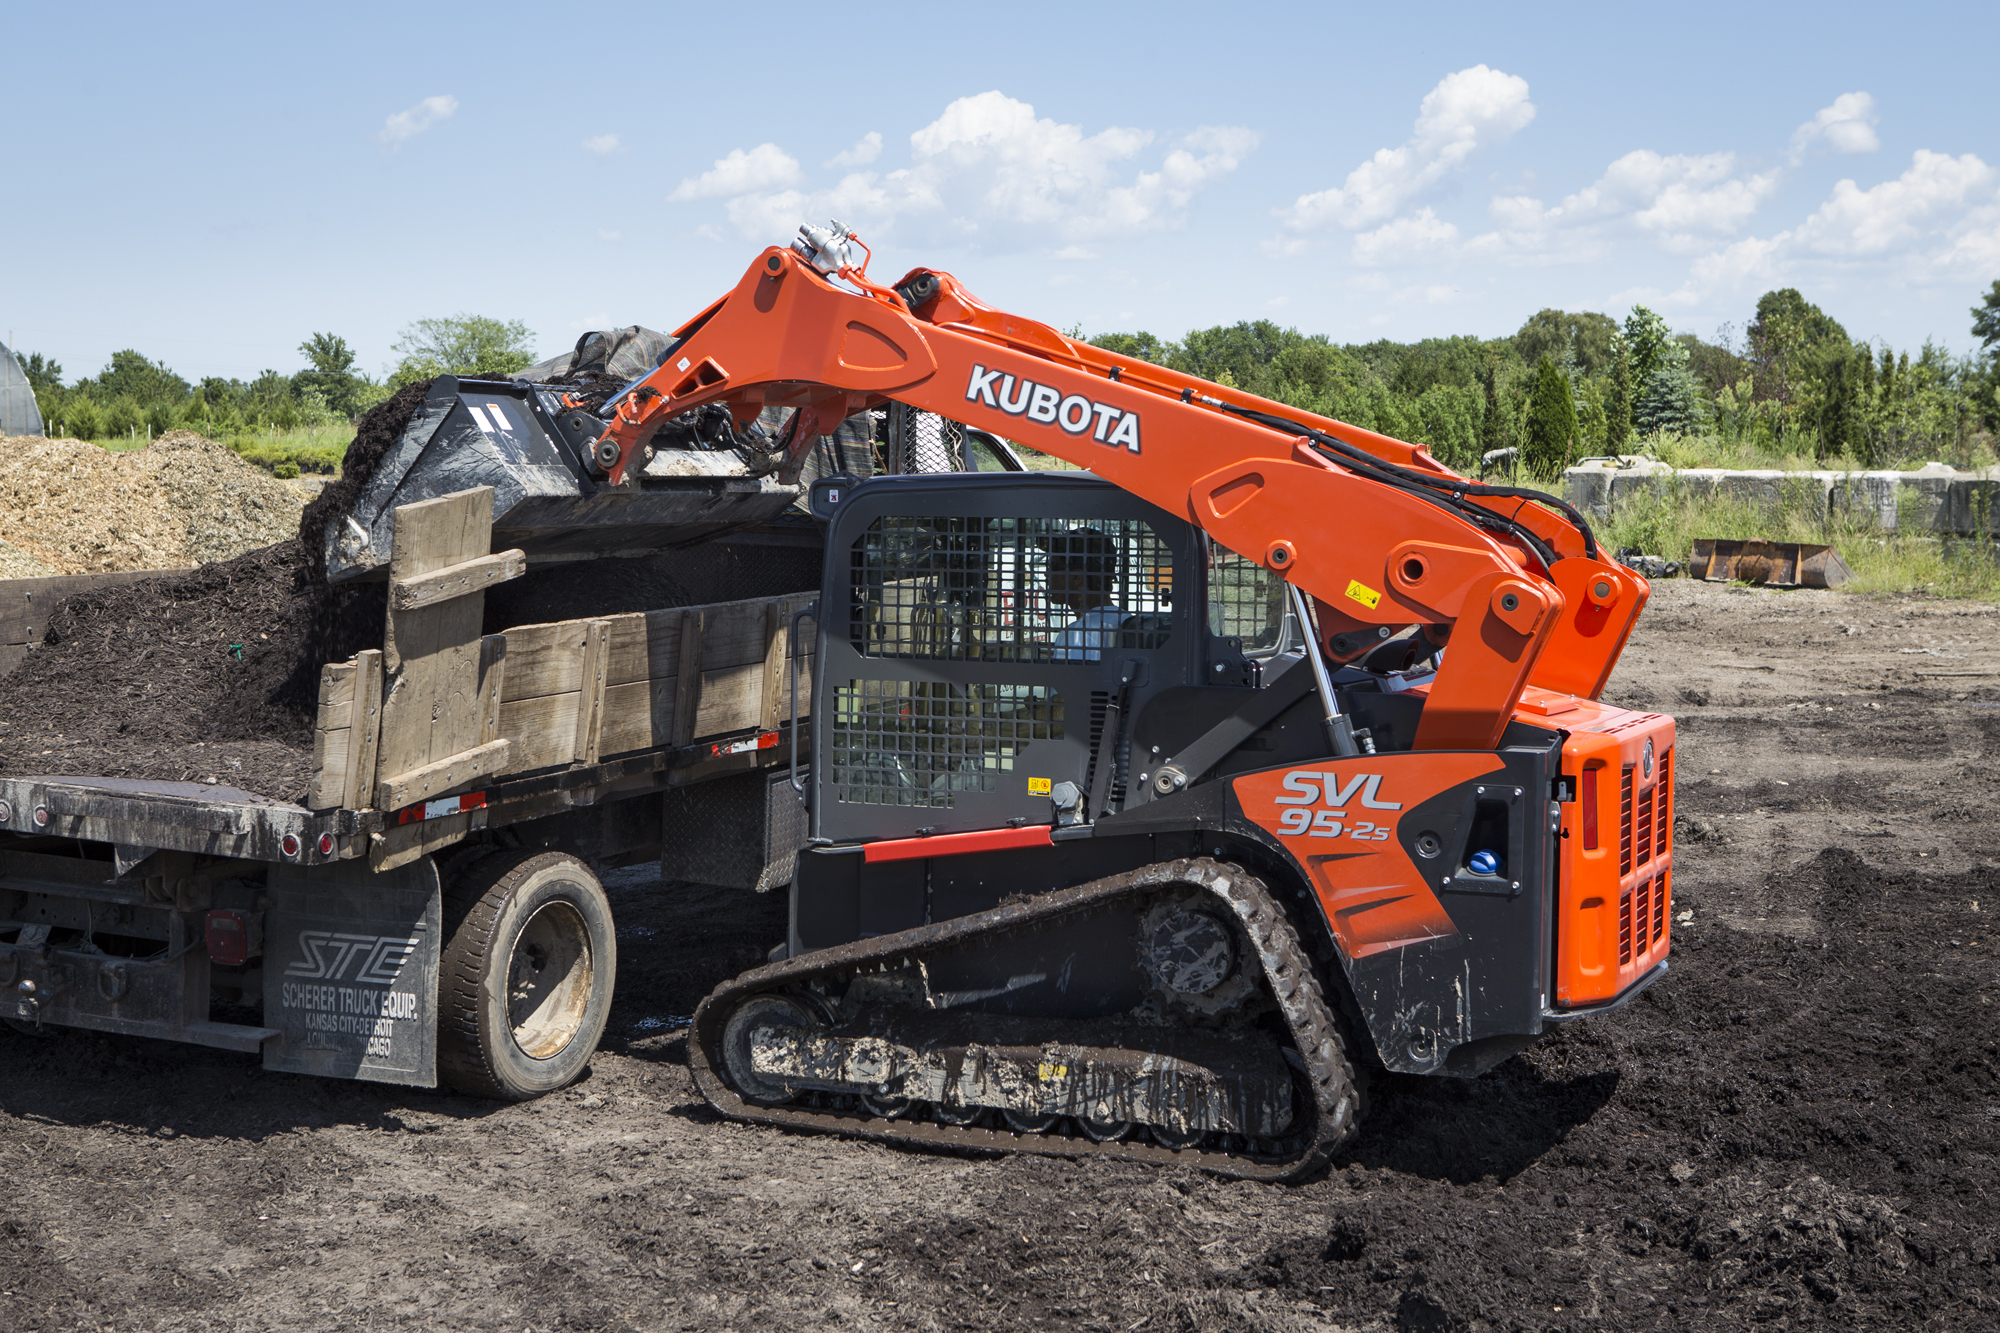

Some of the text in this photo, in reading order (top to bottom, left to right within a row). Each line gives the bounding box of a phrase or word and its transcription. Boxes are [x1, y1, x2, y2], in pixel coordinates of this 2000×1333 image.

[966, 364, 1141, 454] KUBOTA
[1274, 770, 1403, 811] SVL
[282, 982, 418, 1020] SCHERER TRUCK EQUIP.
[305, 1012, 338, 1032] KANSAS
